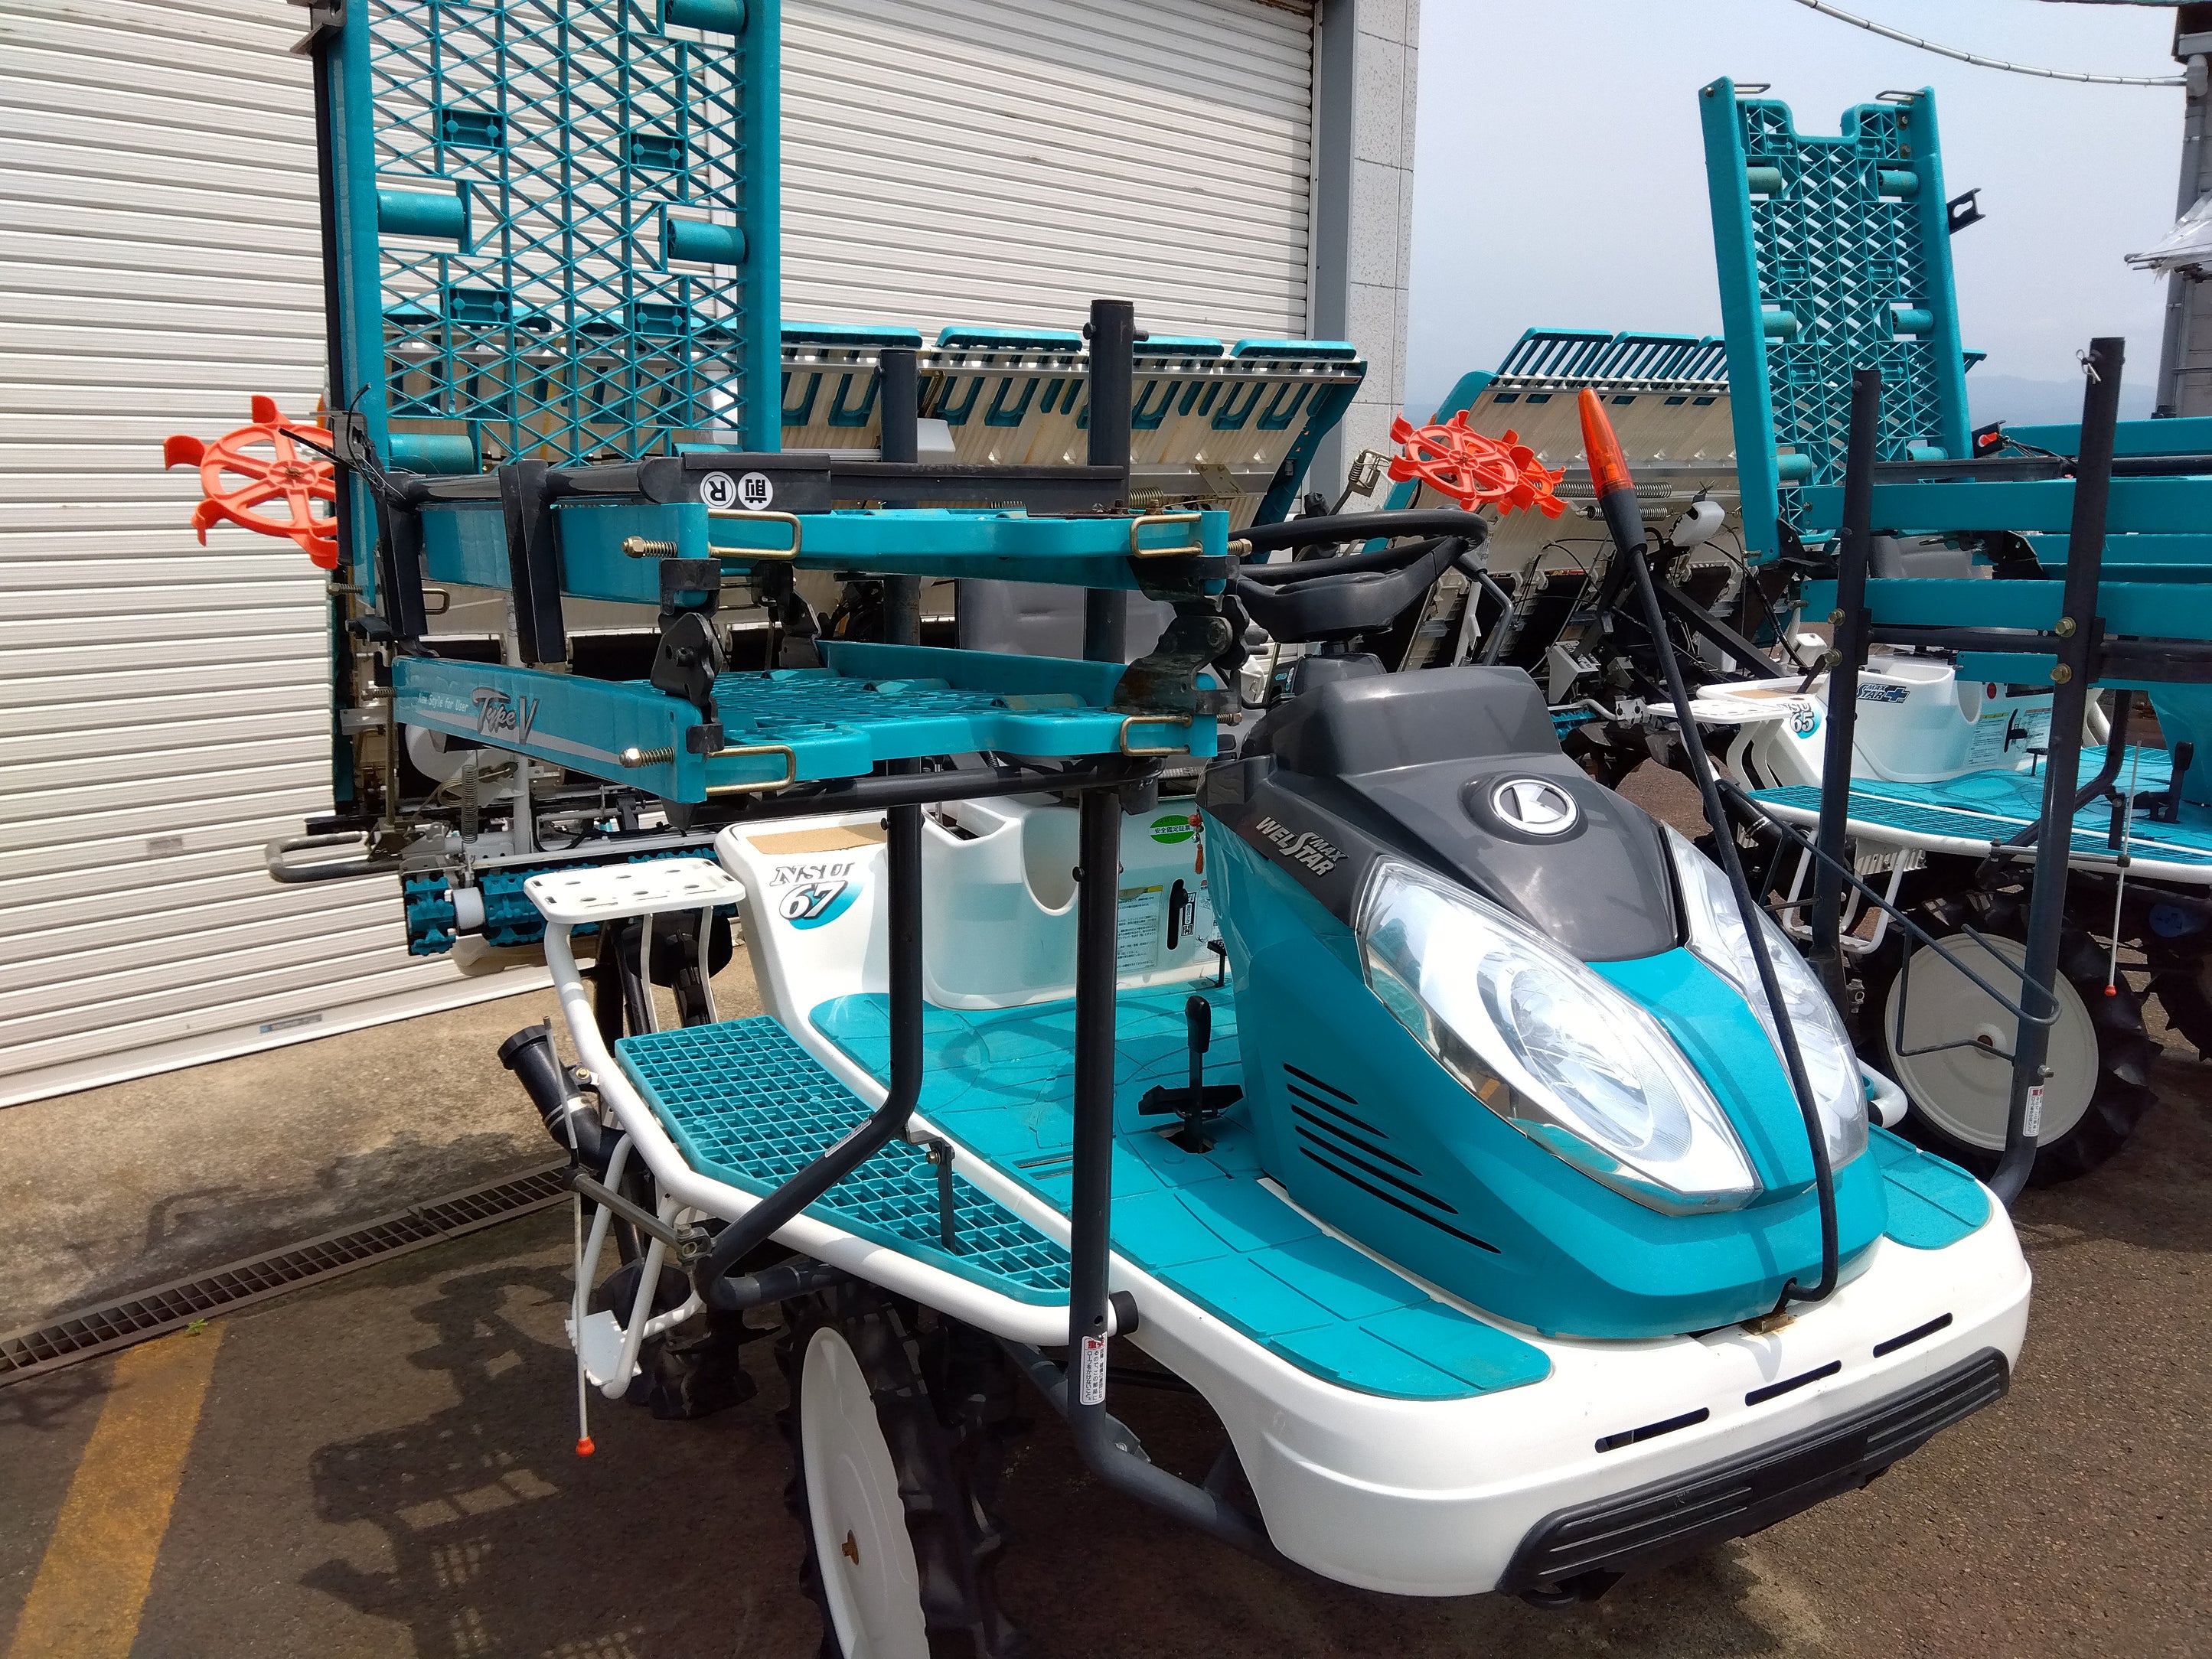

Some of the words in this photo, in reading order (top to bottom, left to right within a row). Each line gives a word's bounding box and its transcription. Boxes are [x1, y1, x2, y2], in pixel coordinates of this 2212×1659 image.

[708, 481, 726, 501] R
[428, 694, 443, 709] Style
[444, 697, 454, 709] for
[455, 699, 469, 712] User
[471, 686, 517, 735] Type
[518, 695, 540, 745] V
[1790, 712, 1815, 733] 65
[778, 880, 848, 921] 67
